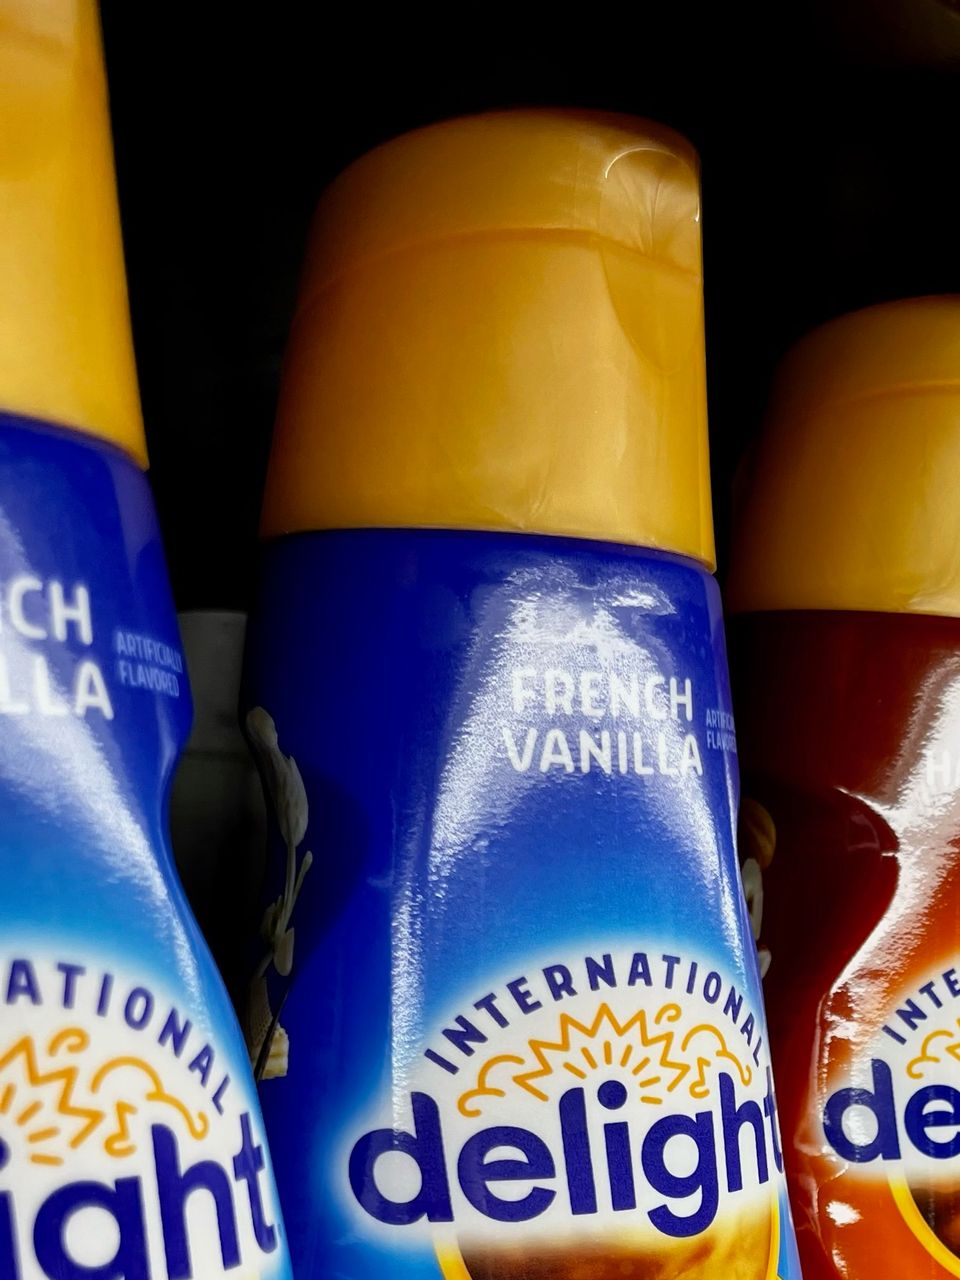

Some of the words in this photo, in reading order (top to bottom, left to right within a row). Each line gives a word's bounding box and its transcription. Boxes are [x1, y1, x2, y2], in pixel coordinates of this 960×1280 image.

[120, 660, 181, 698] FLAVORED
[510, 666, 694, 722] FRENCH
[502, 727, 704, 777] VANILLA
[7, 959, 232, 1116] ATIONAL
[424, 952, 766, 1075] INTERNATIONAL
[347, 1065, 784, 1238] delight
